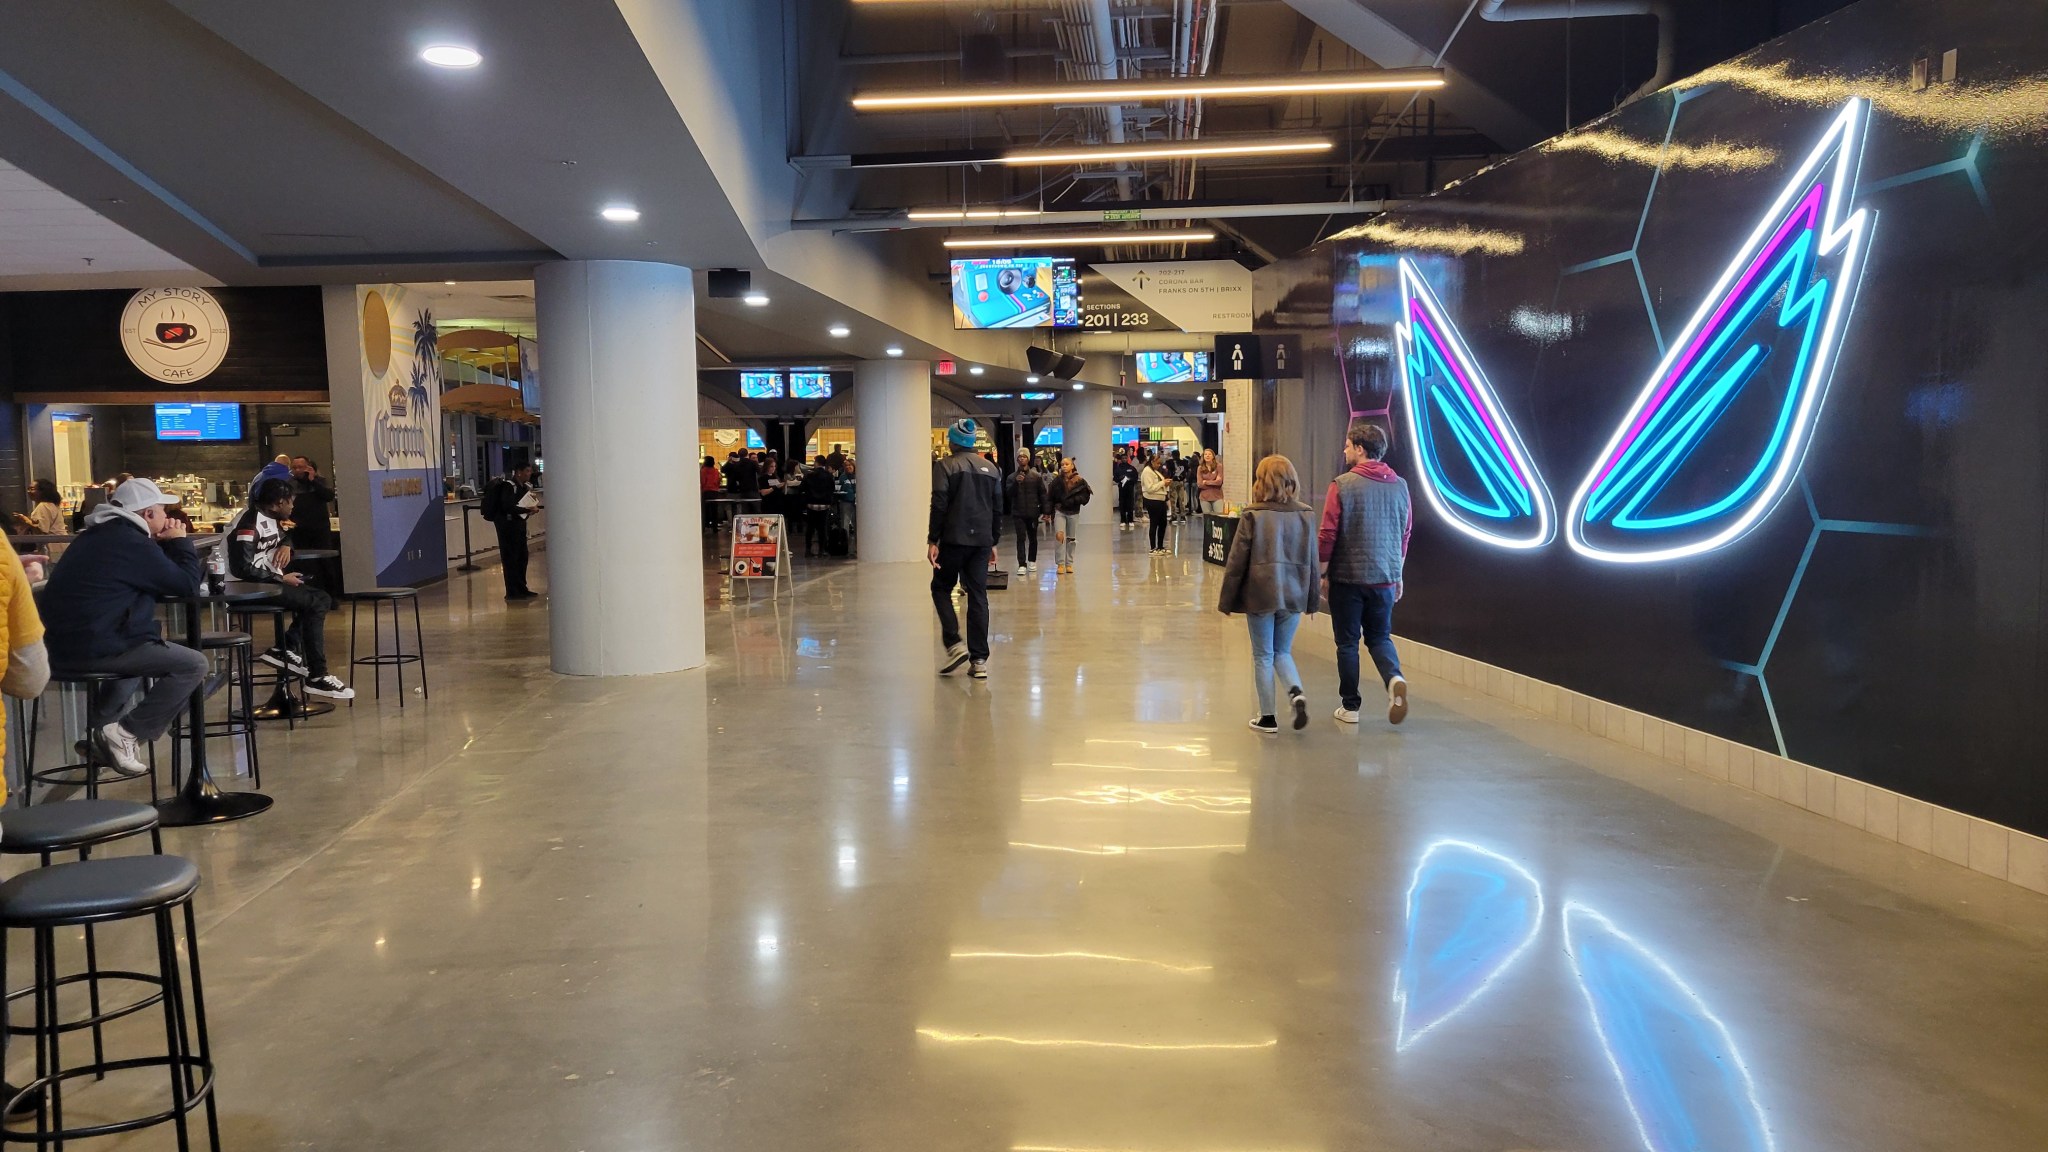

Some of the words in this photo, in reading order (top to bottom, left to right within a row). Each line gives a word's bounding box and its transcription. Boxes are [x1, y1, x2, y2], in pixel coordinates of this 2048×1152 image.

[138, 290, 158, 308] MY
[164, 287, 211, 306] STORY
[1086, 303, 1121, 311] SECTIONS
[1084, 313, 1110, 327] 201
[1121, 312, 1149, 326] 233
[162, 367, 194, 378] CAFE
